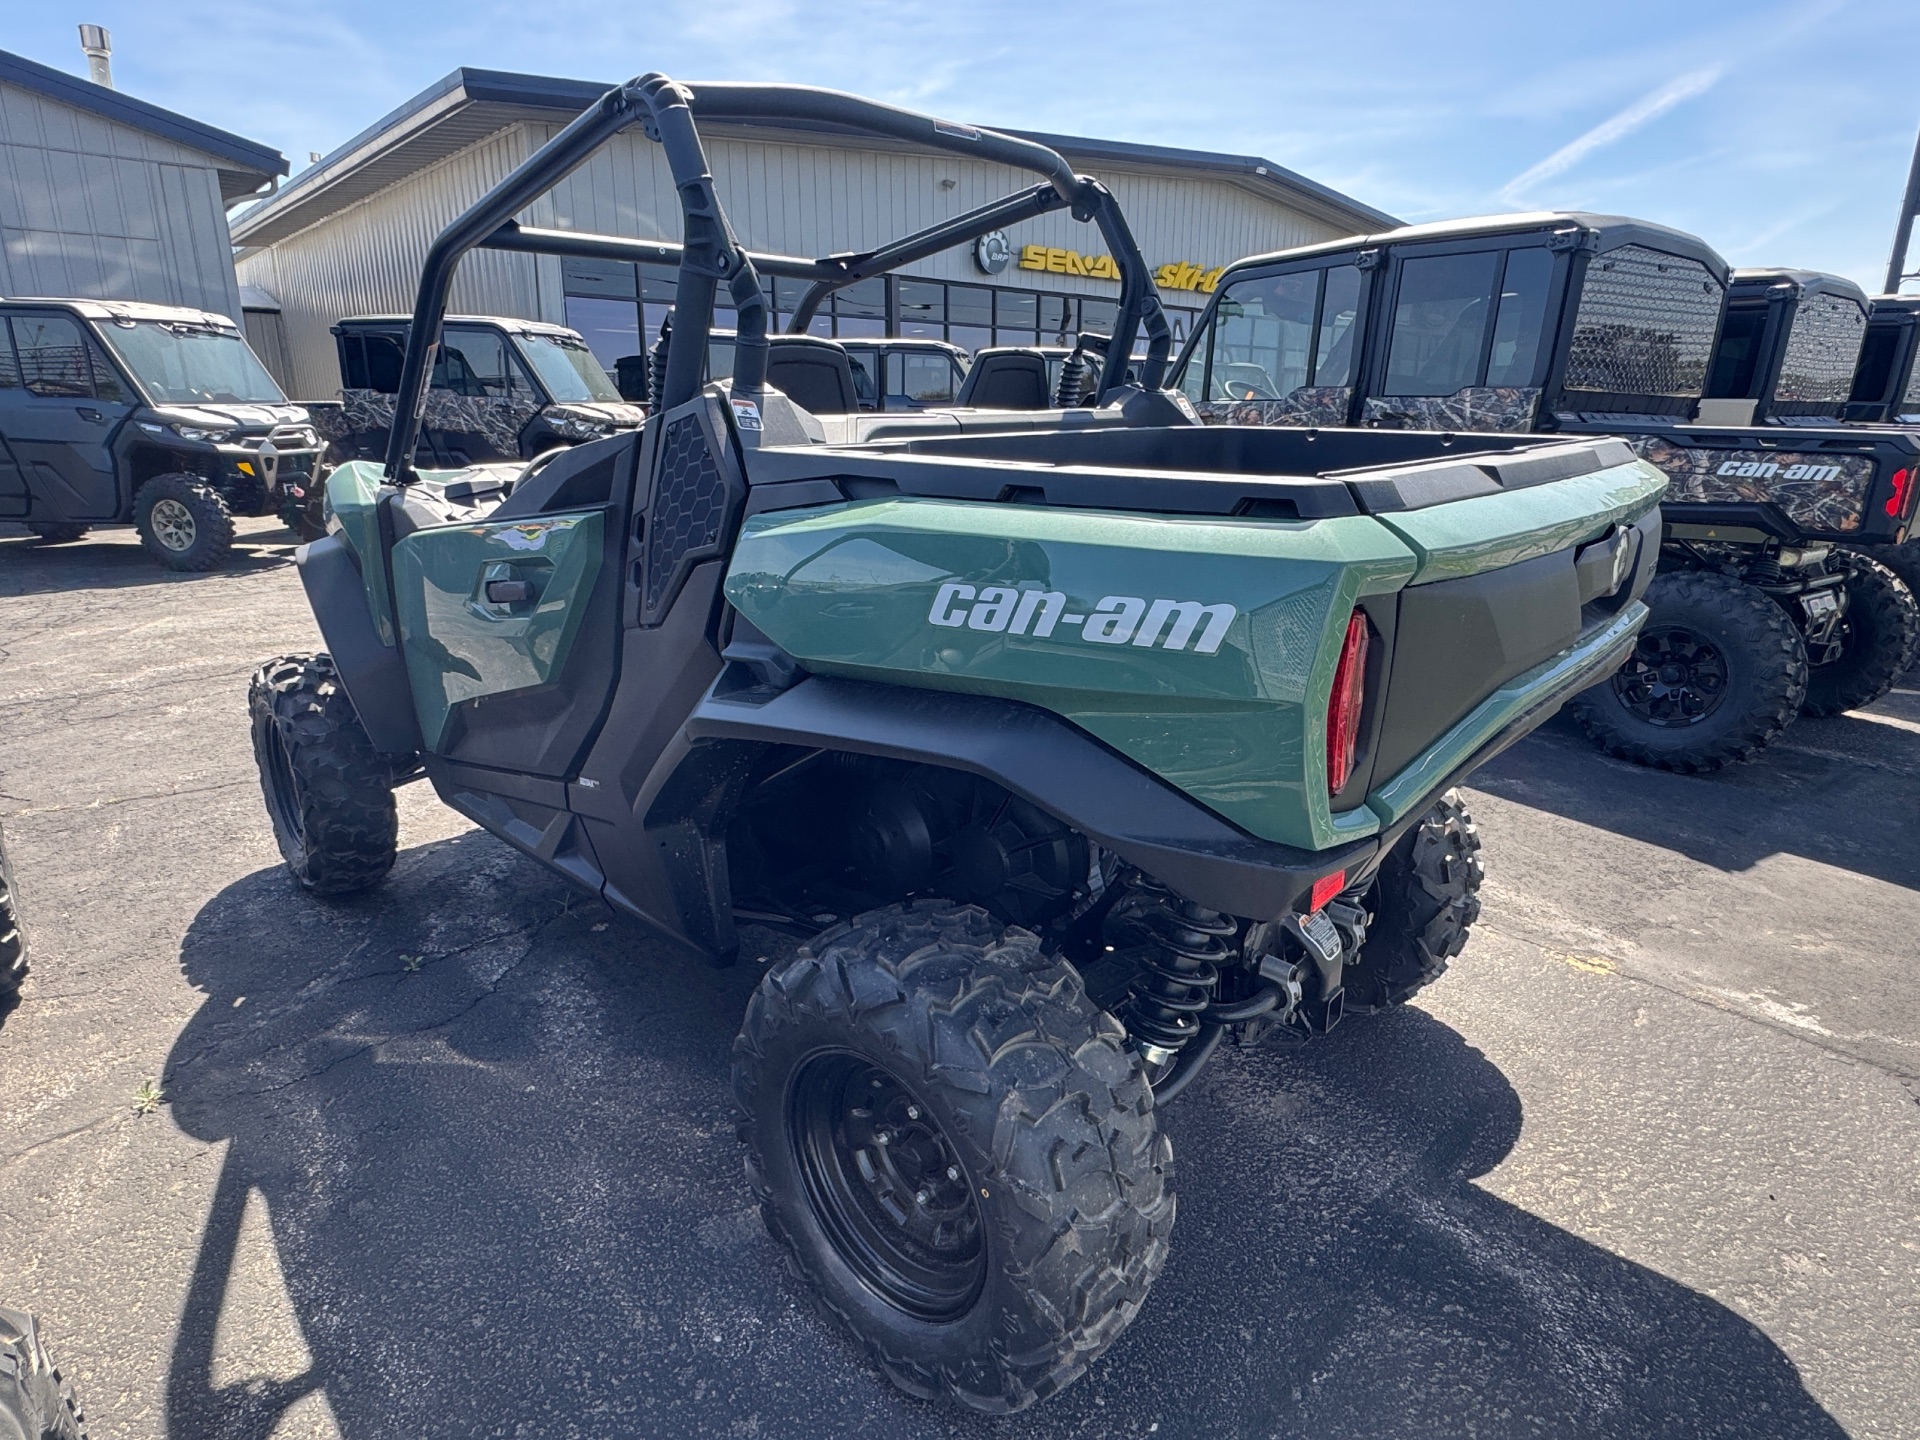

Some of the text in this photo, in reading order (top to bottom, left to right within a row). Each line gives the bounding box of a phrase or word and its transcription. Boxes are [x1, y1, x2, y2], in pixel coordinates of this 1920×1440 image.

[991, 252, 1008, 262] BRP
[1716, 460, 1841, 481] can-am
[928, 583, 1237, 653] can-am
